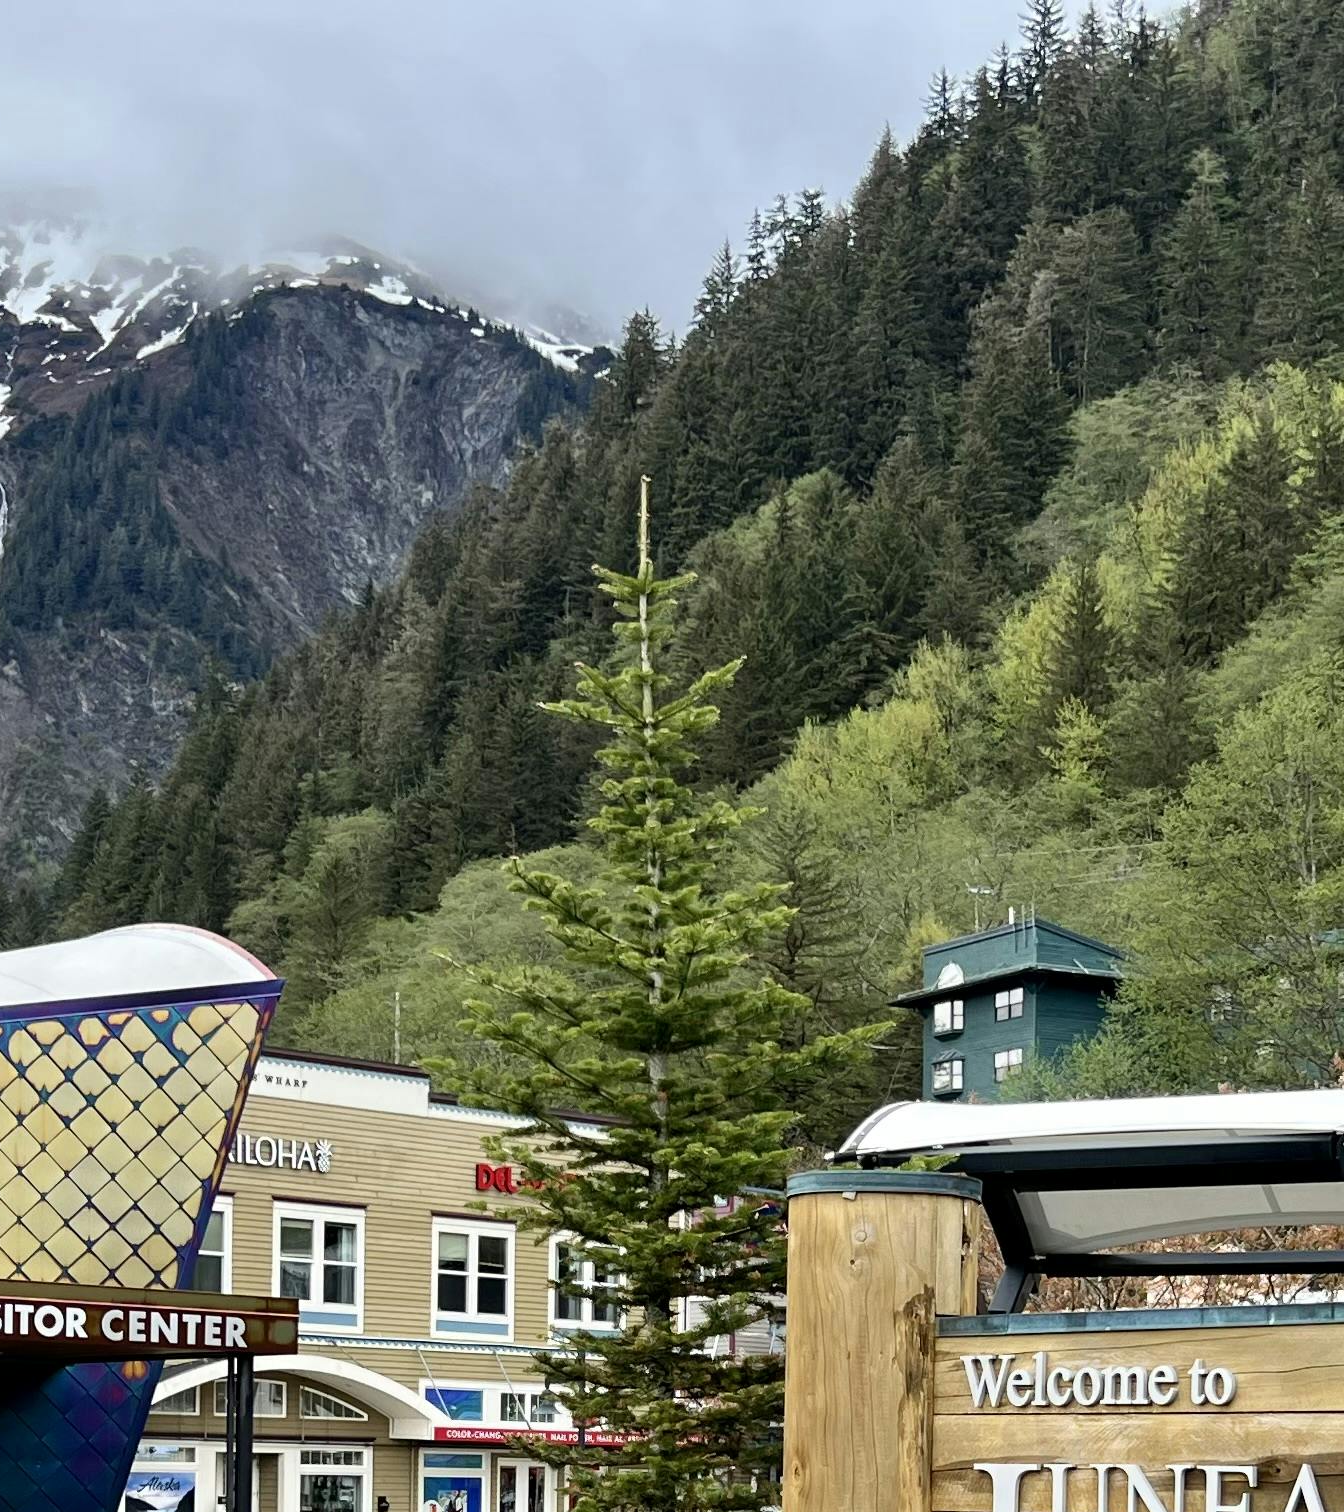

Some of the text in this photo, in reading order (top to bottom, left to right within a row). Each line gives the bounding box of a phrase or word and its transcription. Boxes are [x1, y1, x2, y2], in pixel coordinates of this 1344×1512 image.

[264, 1074, 308, 1088] WHARF
[101, 1309, 248, 1348] CENTER
[959, 1351, 1237, 1408] Welcome to
[137, 1474, 181, 1493] Alaska
